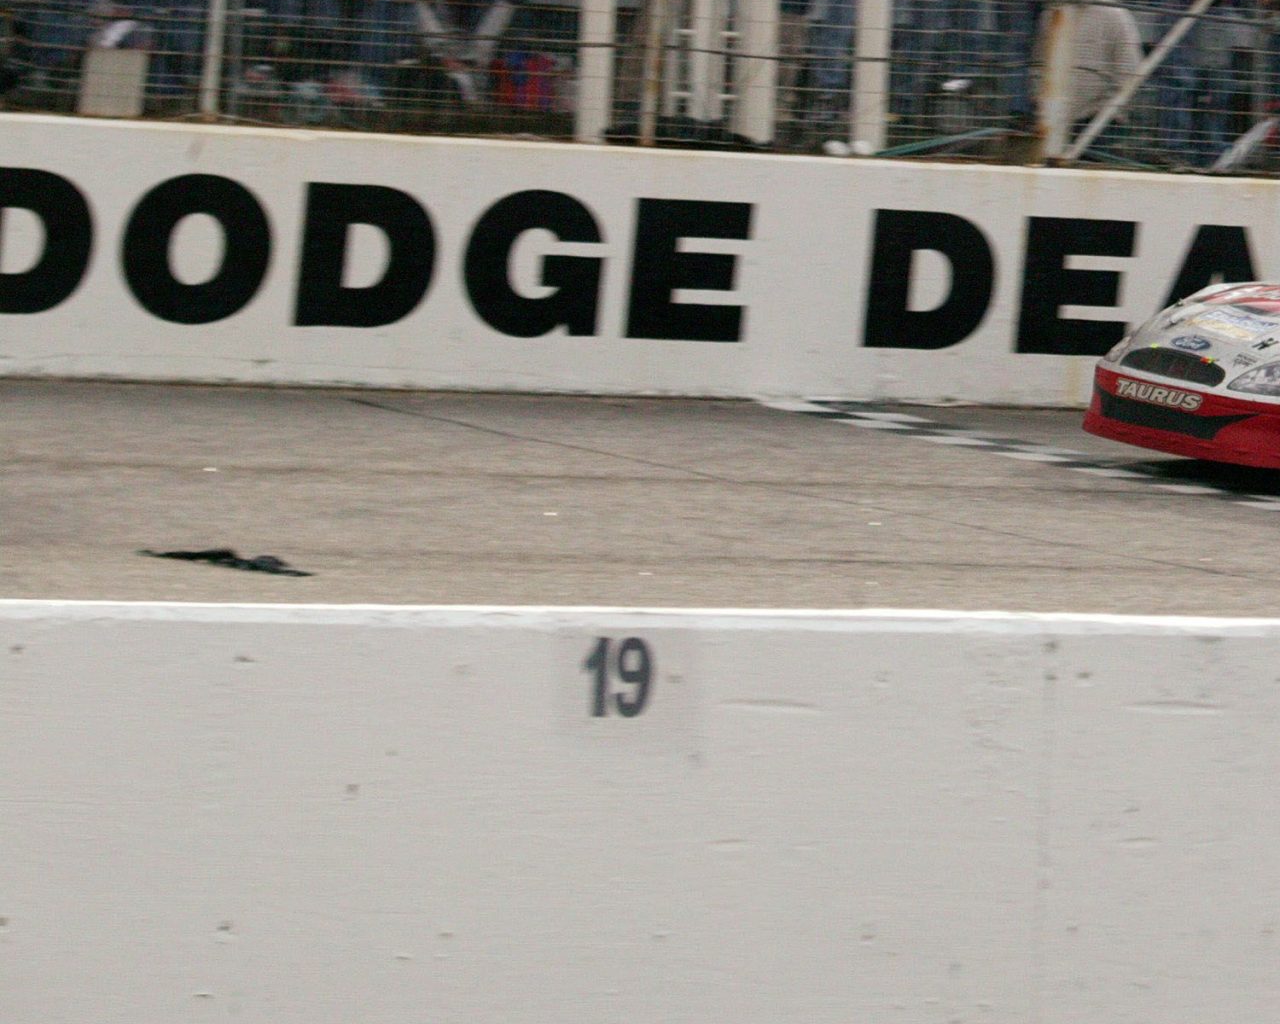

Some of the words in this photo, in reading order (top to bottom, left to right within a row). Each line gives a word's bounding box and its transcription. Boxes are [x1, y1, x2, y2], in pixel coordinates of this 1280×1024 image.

[0, 166, 757, 343] DODGE
[1115, 377, 1203, 412] TAURUS
[583, 636, 654, 718] 19
